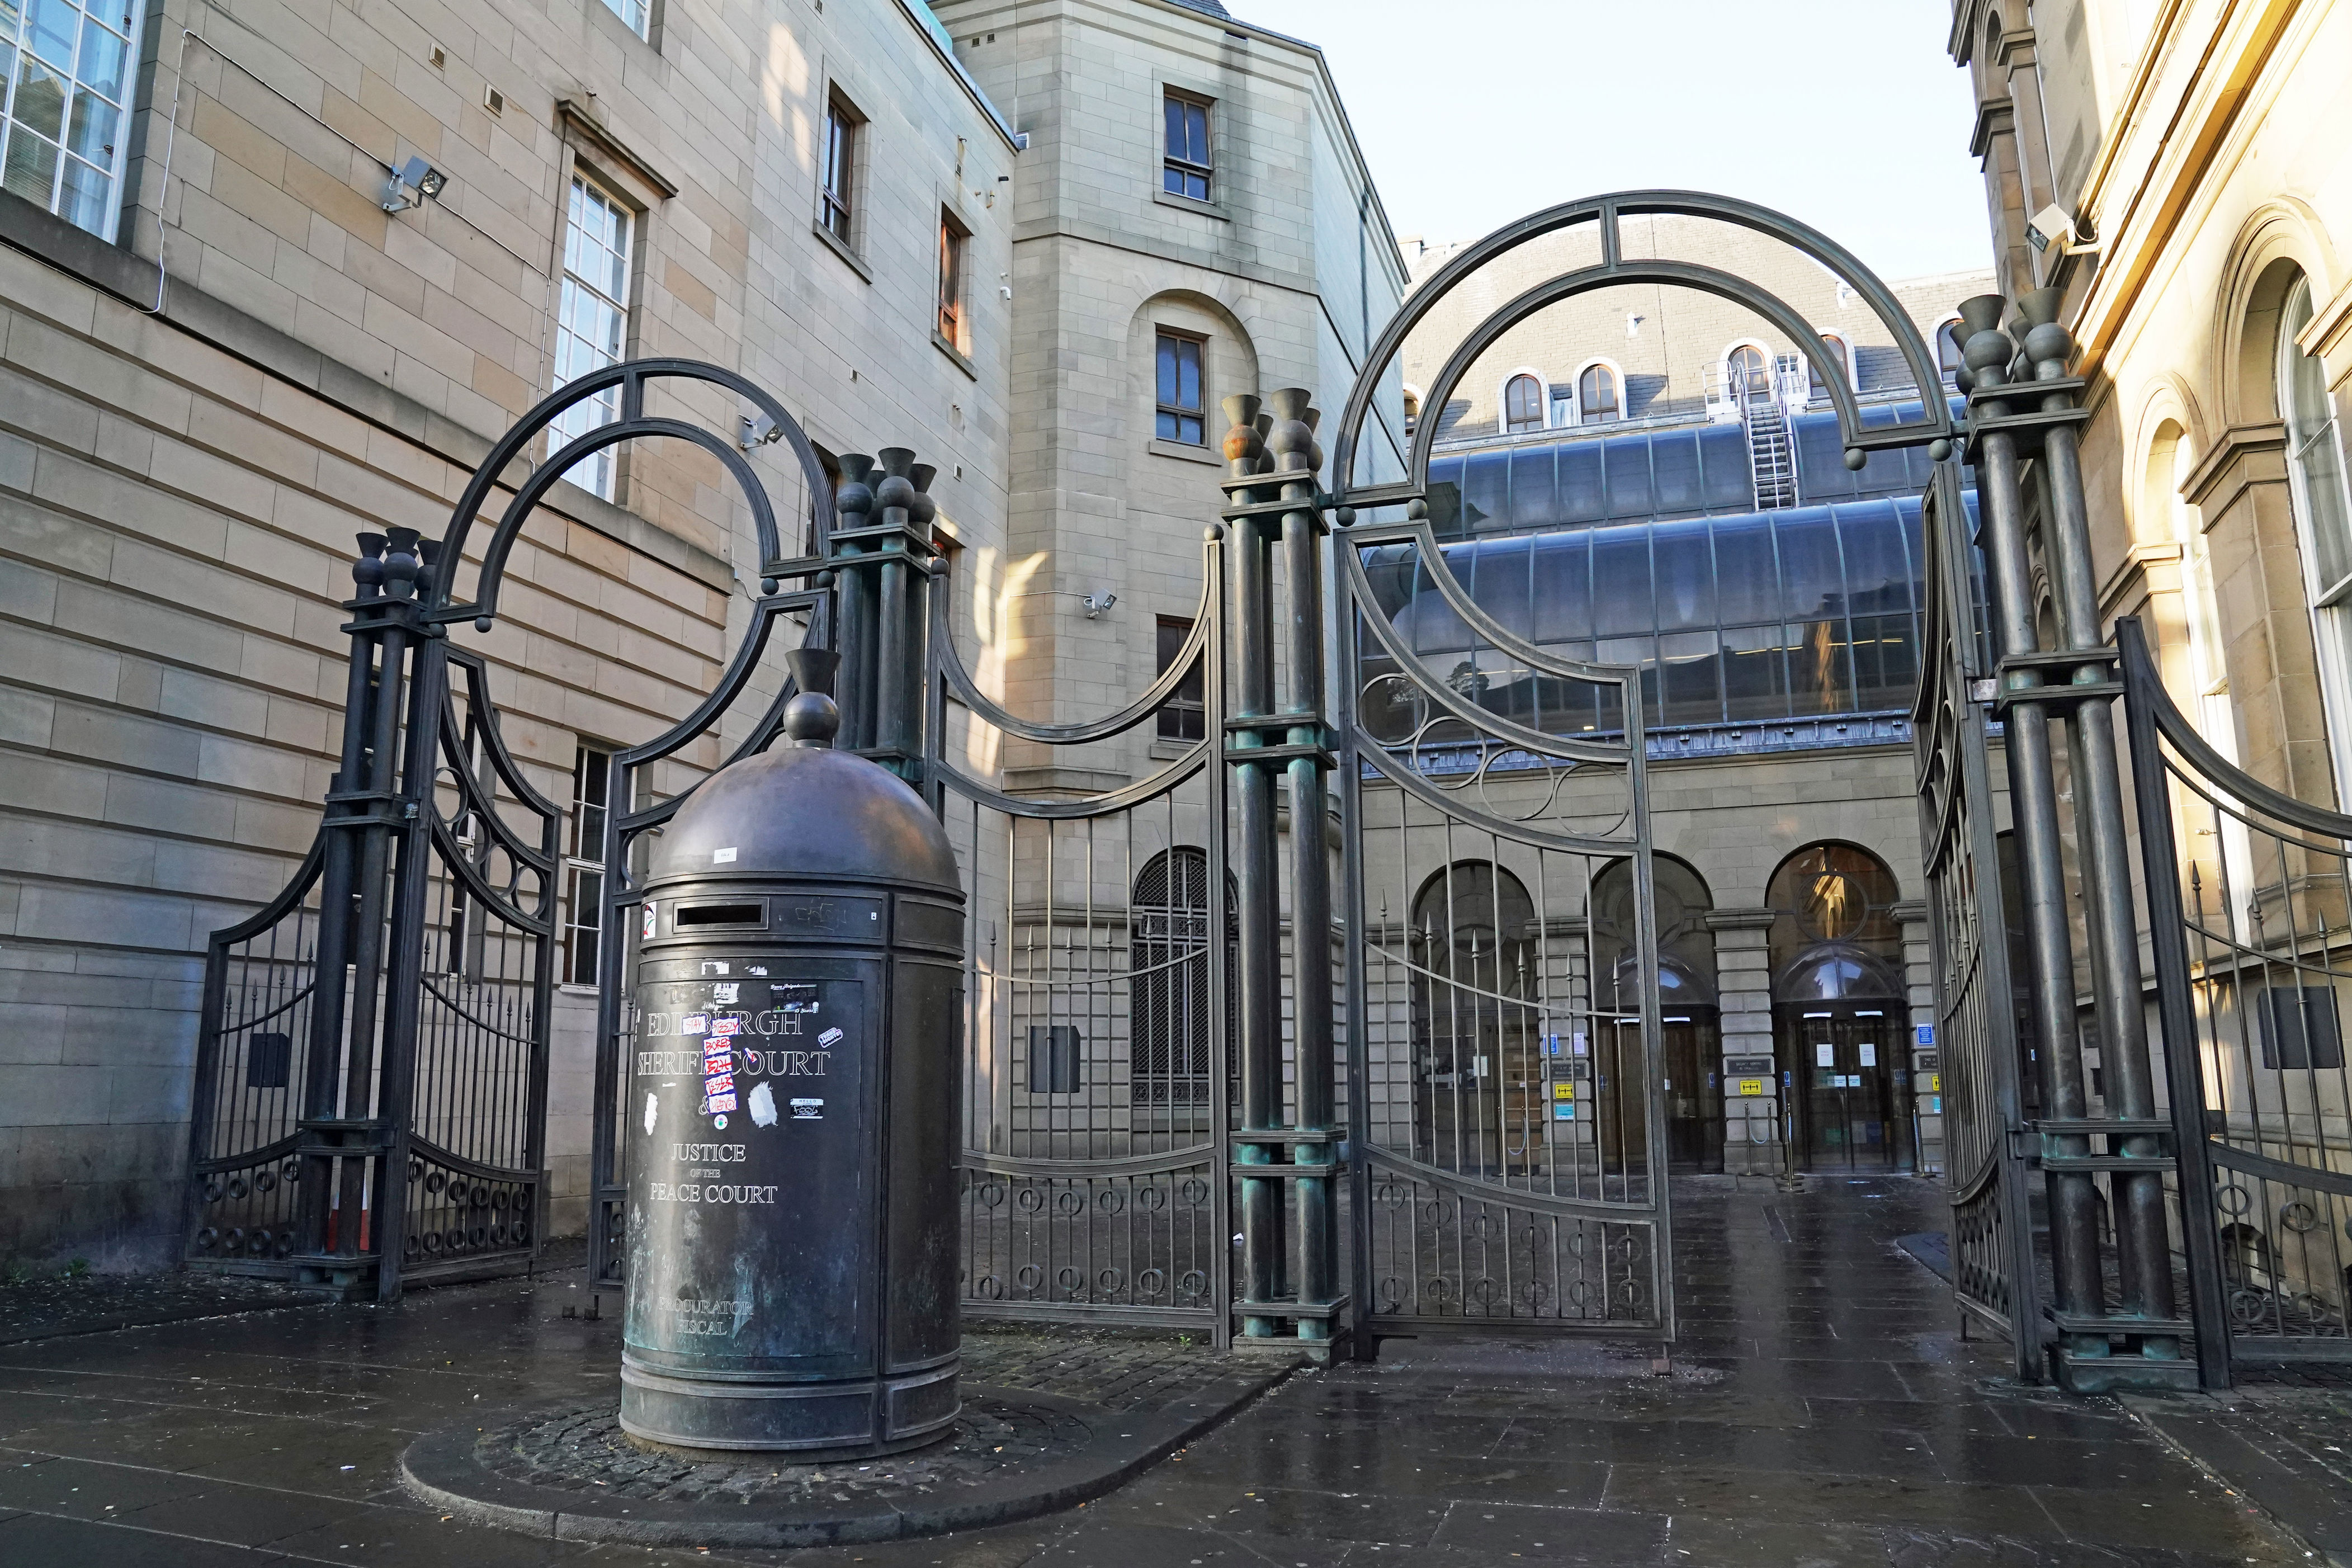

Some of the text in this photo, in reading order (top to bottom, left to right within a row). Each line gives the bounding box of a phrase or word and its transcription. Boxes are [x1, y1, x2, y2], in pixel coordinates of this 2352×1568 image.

[686, 1019, 702, 1032] STAY
[706, 1038, 731, 1055] BORED
[726, 1050, 831, 1076] COURT
[670, 1143, 747, 1162] JUSTICE
[689, 1169, 721, 1178] OF THE
[650, 1183, 778, 1203] PEACE COURT
[659, 1296, 754, 1315] PROCURATOR
[677, 1319, 728, 1335] FISCAL
